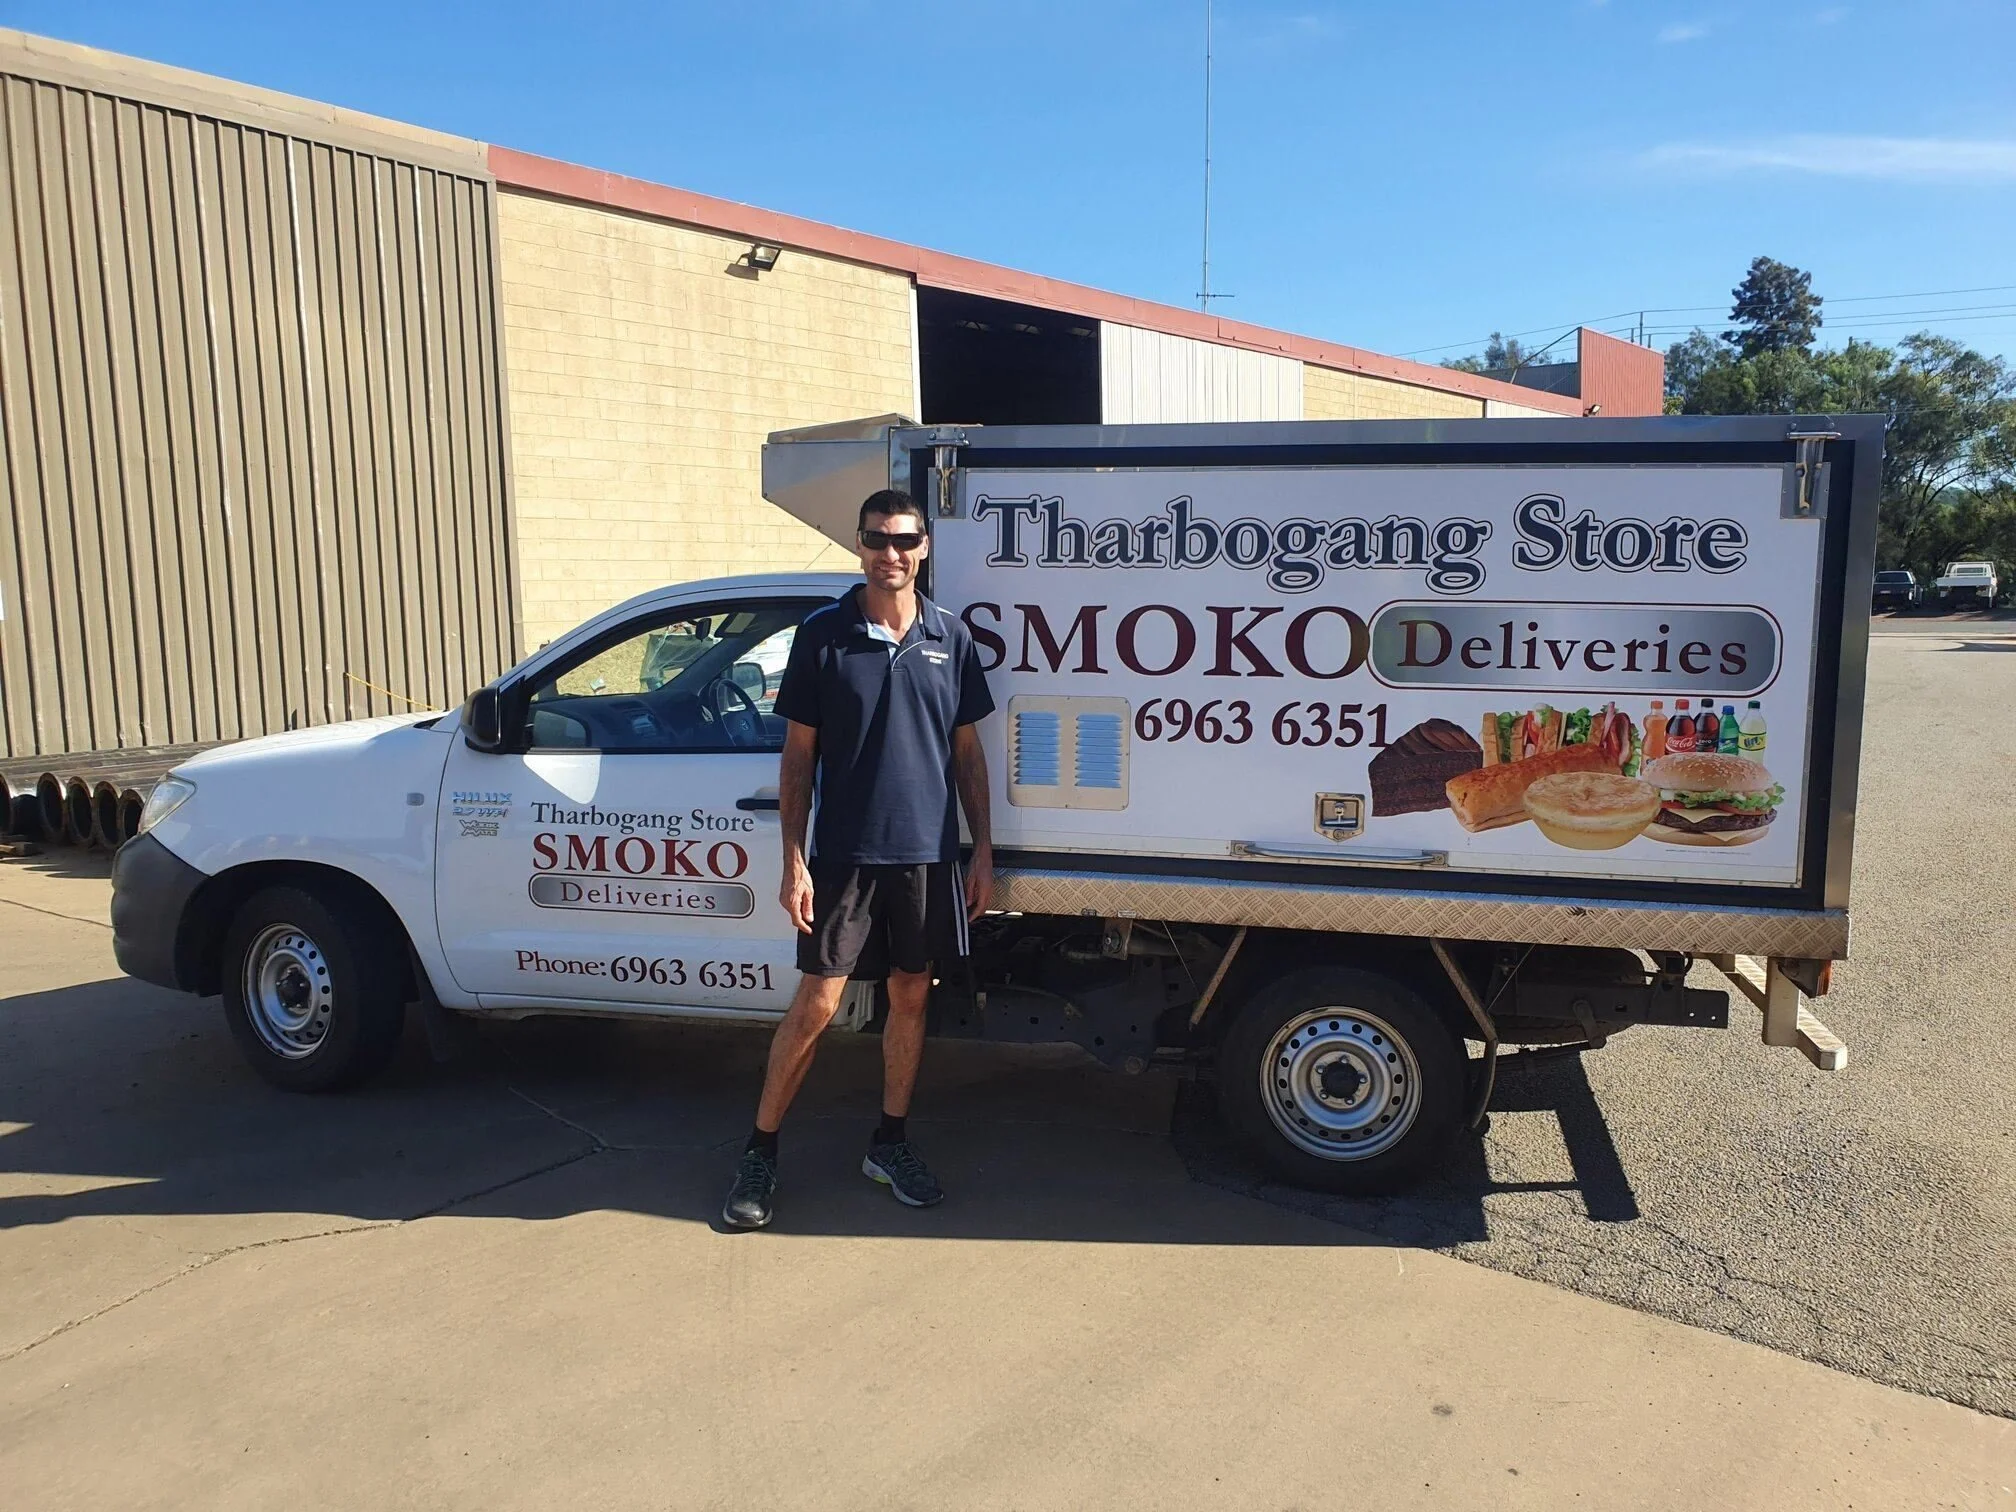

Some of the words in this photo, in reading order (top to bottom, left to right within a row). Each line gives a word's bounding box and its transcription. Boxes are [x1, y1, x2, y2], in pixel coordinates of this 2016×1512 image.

[972, 494, 1493, 595] Tharbogang
[1512, 493, 1748, 575] Store
[959, 602, 1370, 680] SMOKO
[1397, 618, 1748, 676] Deliveries
[1134, 698, 1254, 744] 6963
[1271, 701, 1389, 748] 6351
[531, 801, 683, 836] Tharbogang
[691, 808, 755, 832] Store
[532, 833, 749, 879] SMOKO
[561, 881, 716, 910] Deliveries
[514, 950, 607, 977] Phone:
[610, 955, 688, 985] 6963
[699, 961, 775, 991] 6351
